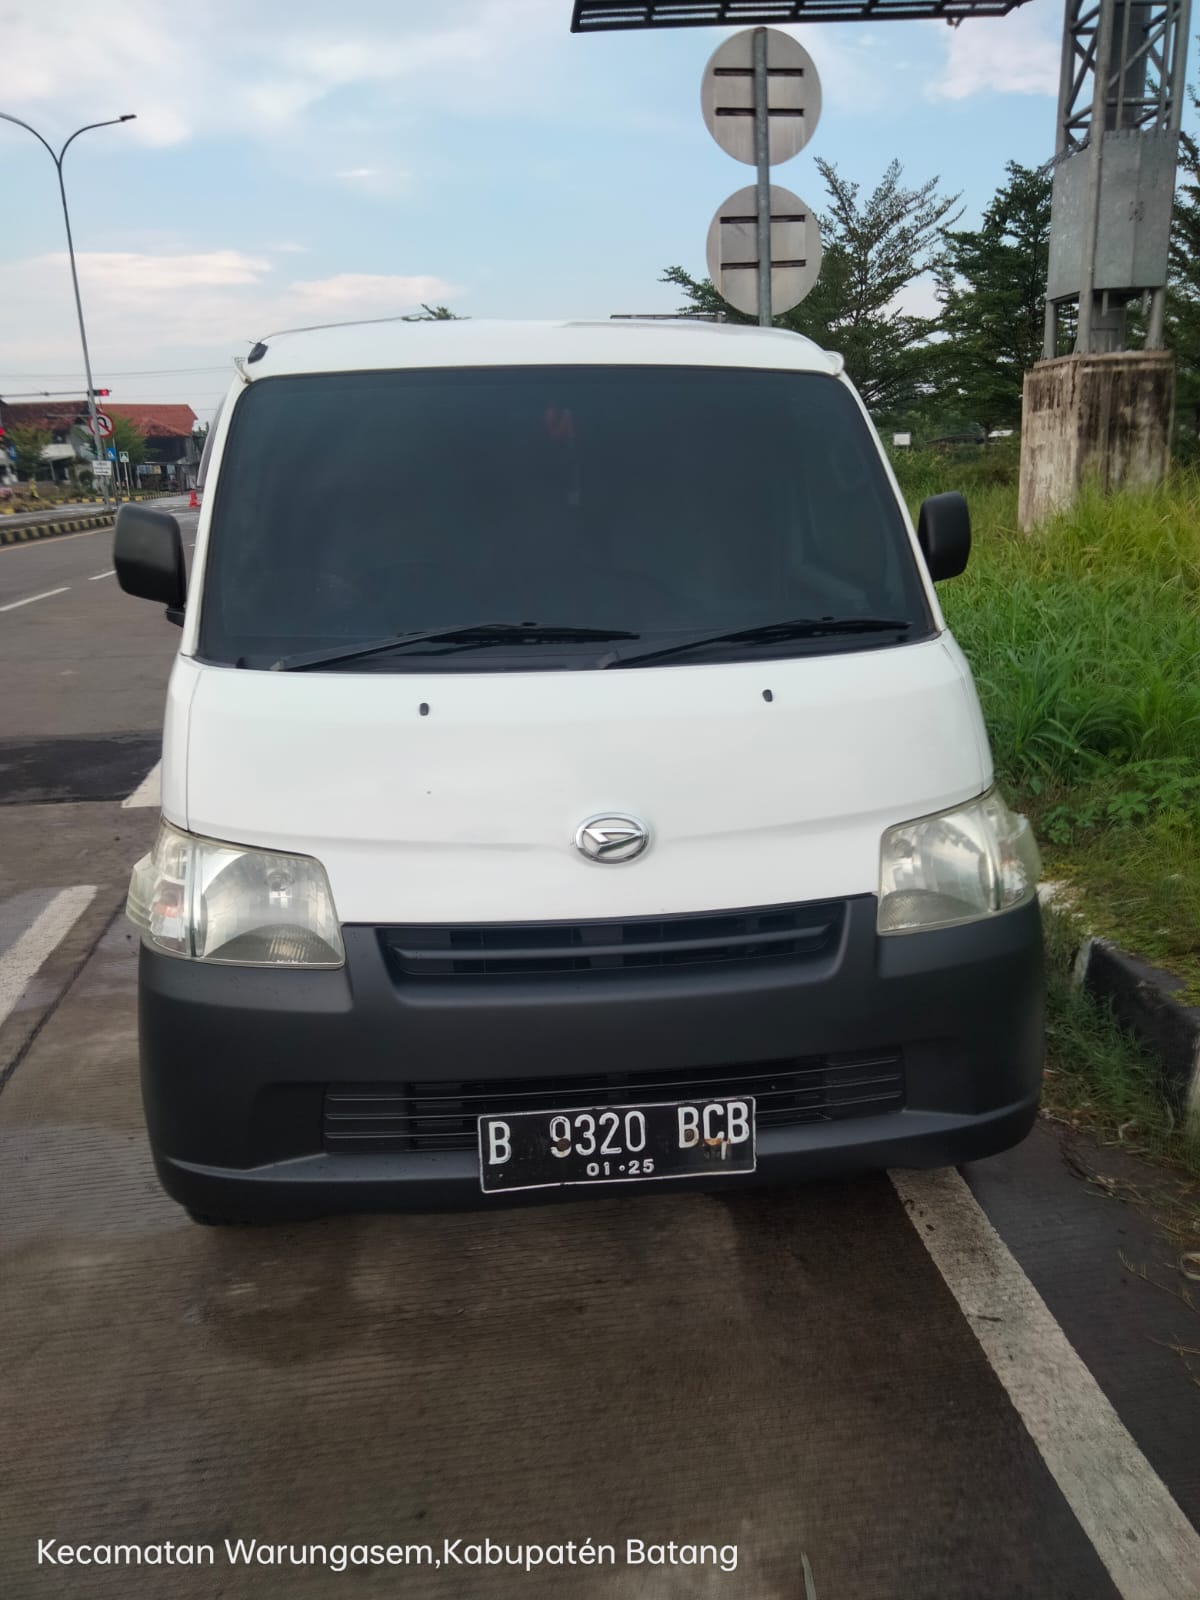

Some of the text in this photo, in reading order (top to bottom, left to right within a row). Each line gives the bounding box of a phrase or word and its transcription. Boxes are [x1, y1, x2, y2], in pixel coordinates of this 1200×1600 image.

[488, 1101, 750, 1165] B 9320 BCB
